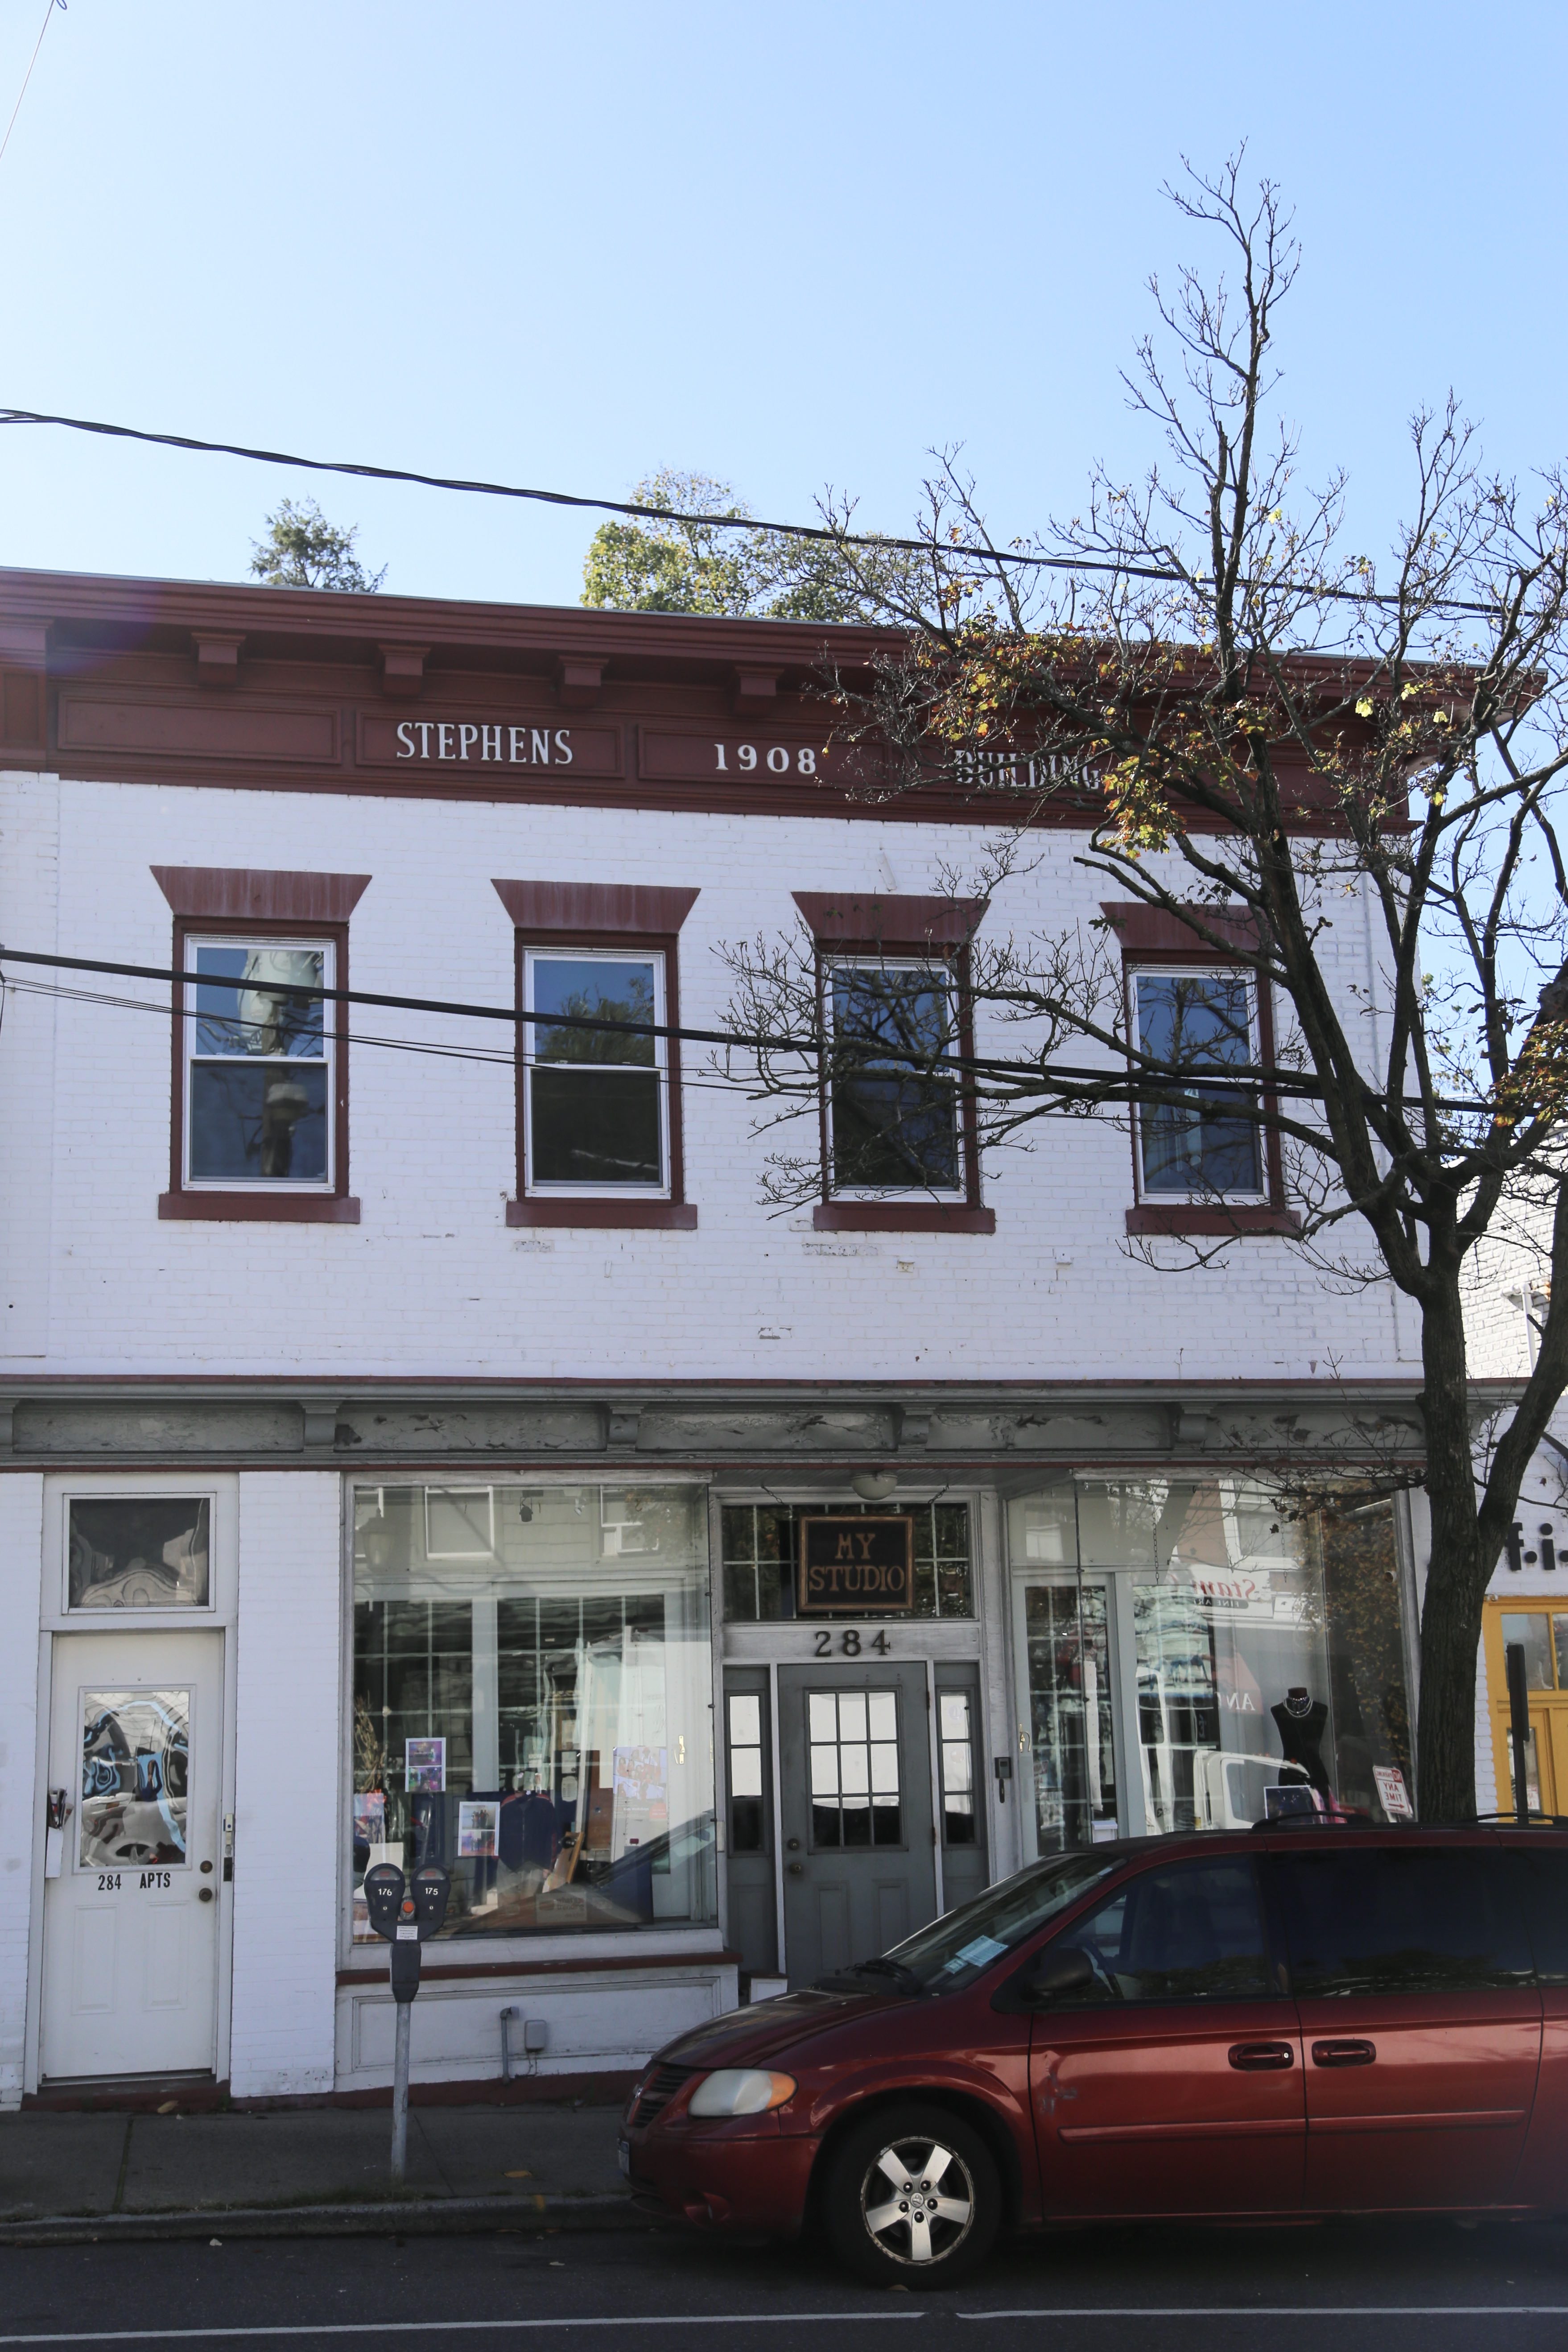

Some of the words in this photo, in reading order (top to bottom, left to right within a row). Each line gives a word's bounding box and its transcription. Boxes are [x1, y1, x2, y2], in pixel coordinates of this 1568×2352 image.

[396, 722, 573, 765] STEPHENS
[714, 744, 816, 775] 1908
[954, 750, 1099, 790] BUILDING
[834, 1533, 876, 1559] MY
[809, 1565, 905, 1591] STUDIO
[814, 1629, 891, 1656] 284
[98, 1874, 121, 1891] 284
[140, 1872, 170, 1889] APTS
[378, 1888, 392, 1896] 176
[425, 1887, 438, 1895] 175
